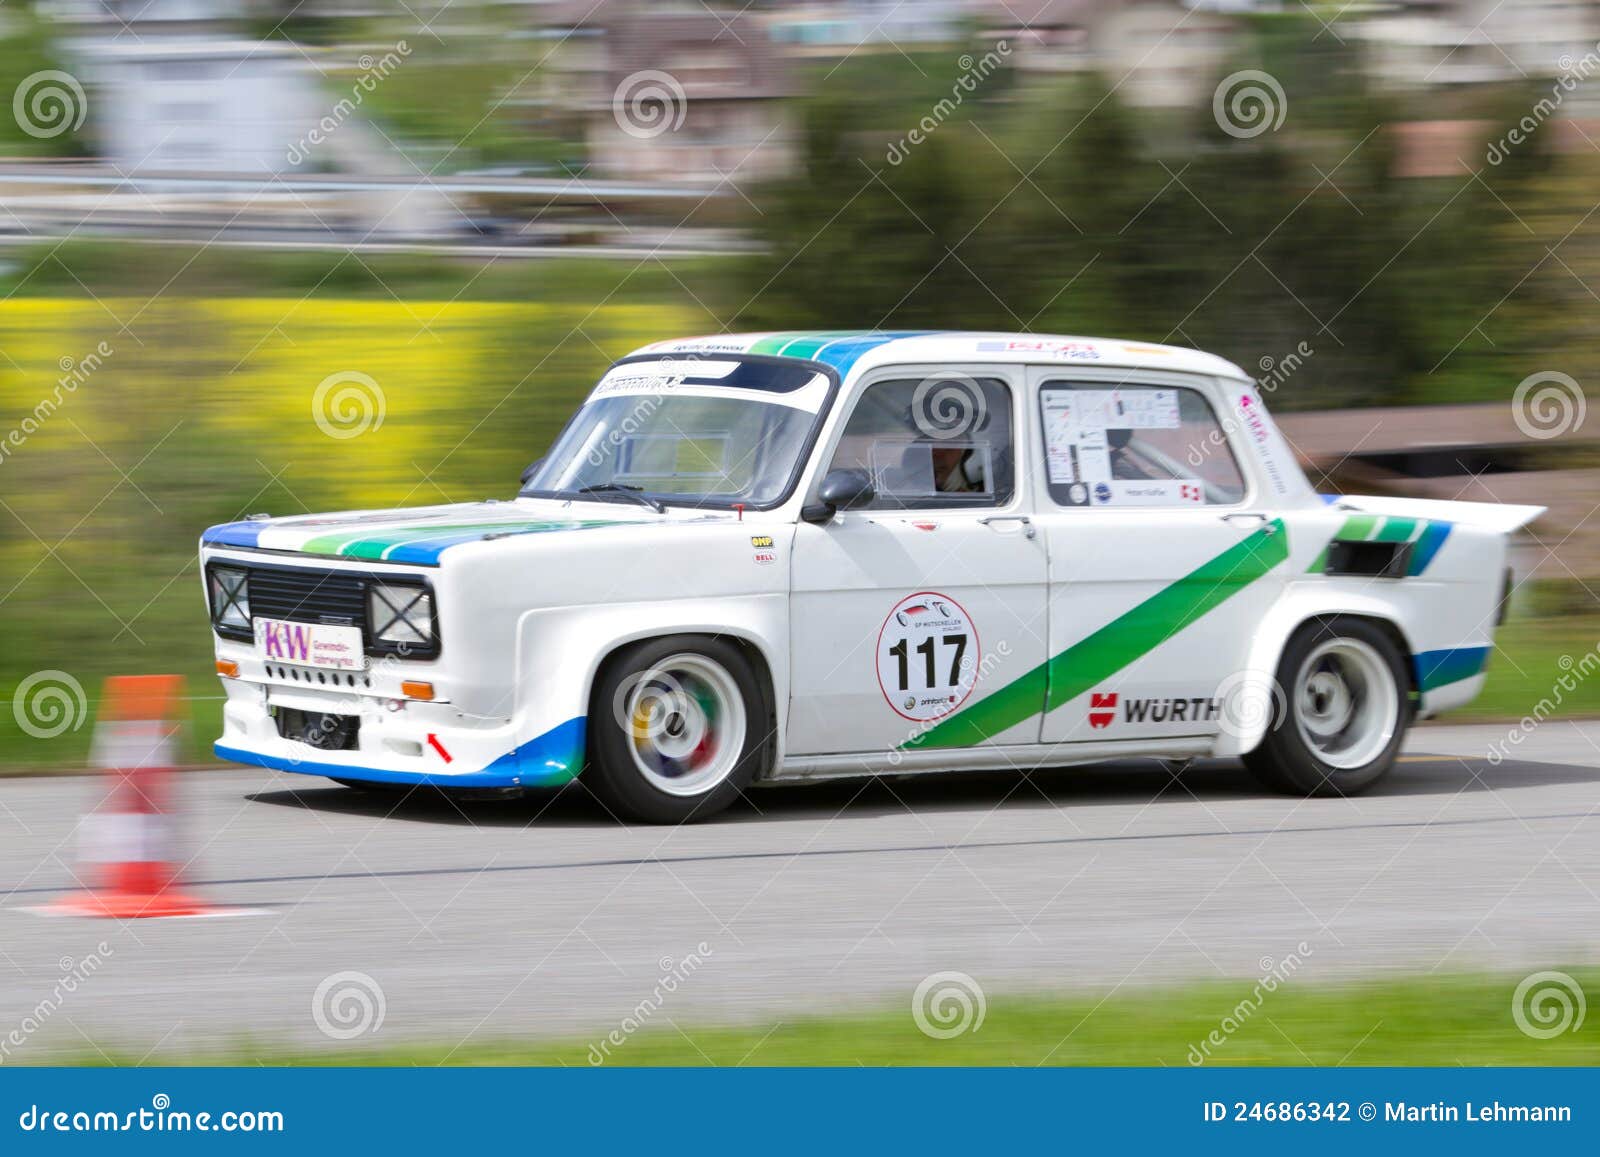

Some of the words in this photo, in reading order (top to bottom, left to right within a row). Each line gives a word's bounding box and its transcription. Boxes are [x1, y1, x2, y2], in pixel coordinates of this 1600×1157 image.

[264, 622, 312, 662] KW
[889, 634, 967, 691] 117
[1124, 698, 1224, 723] WÜRTH
